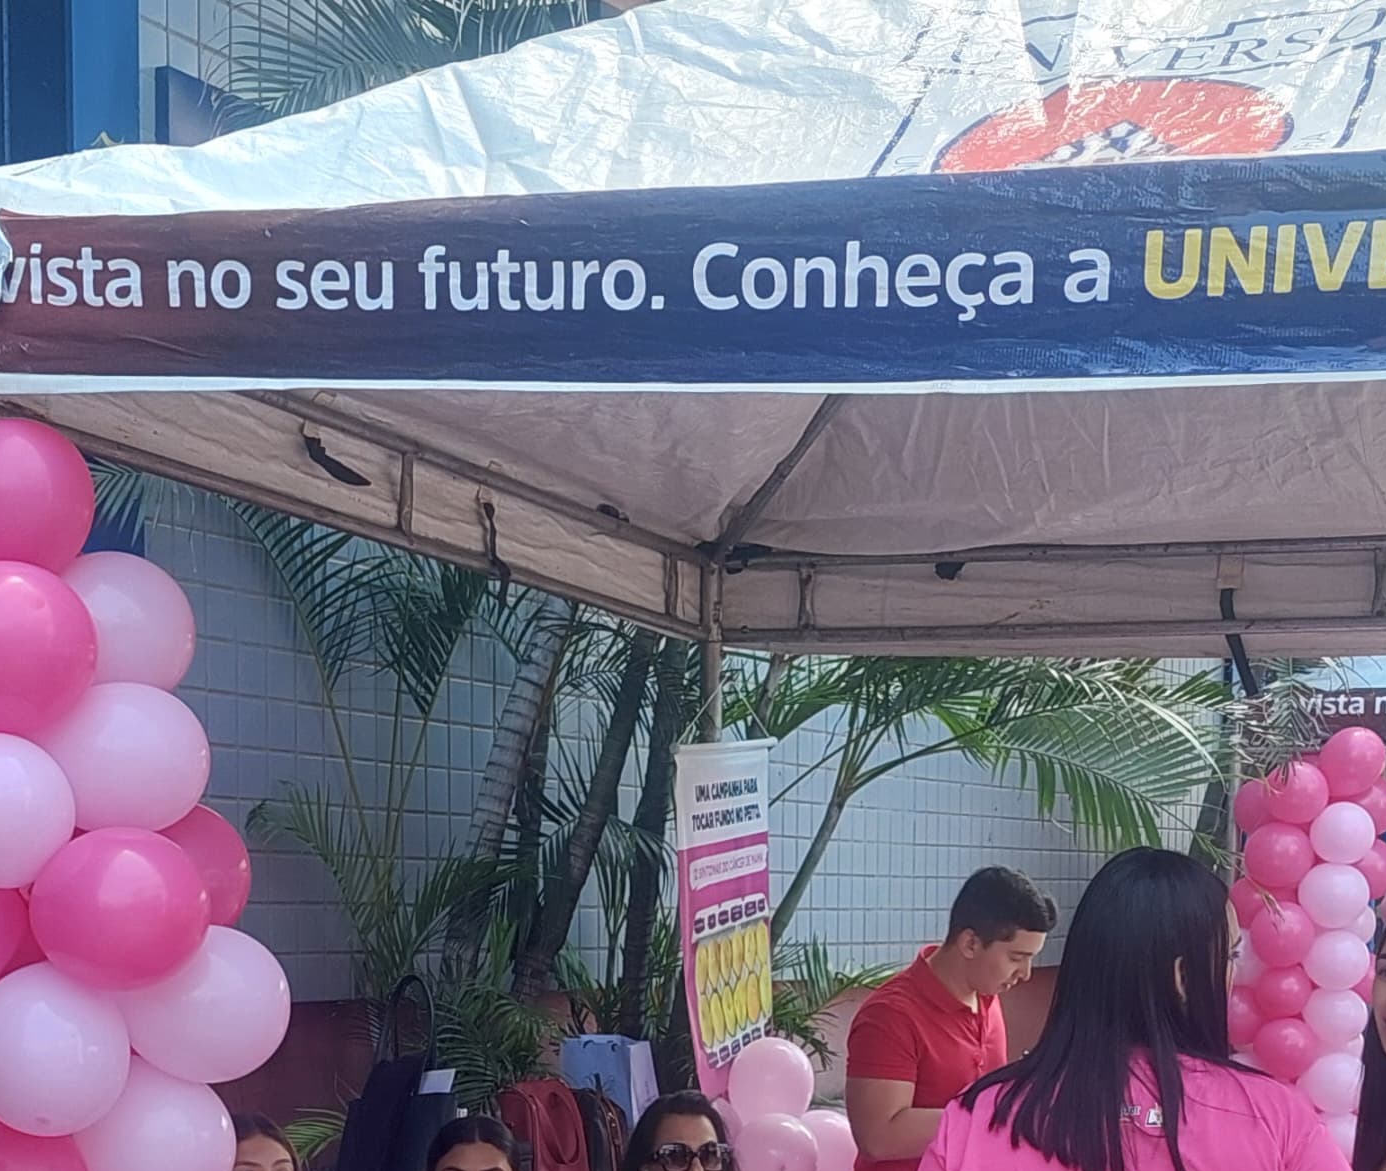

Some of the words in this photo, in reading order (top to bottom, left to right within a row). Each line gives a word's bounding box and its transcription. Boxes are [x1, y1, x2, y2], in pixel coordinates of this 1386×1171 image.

[168, 255, 249, 312] no
[275, 255, 395, 312] seu
[419, 244, 665, 312] futuro.
[692, 240, 1035, 322] Conheça
[1063, 246, 1110, 304] a
[695, 784, 710, 803] UMA
